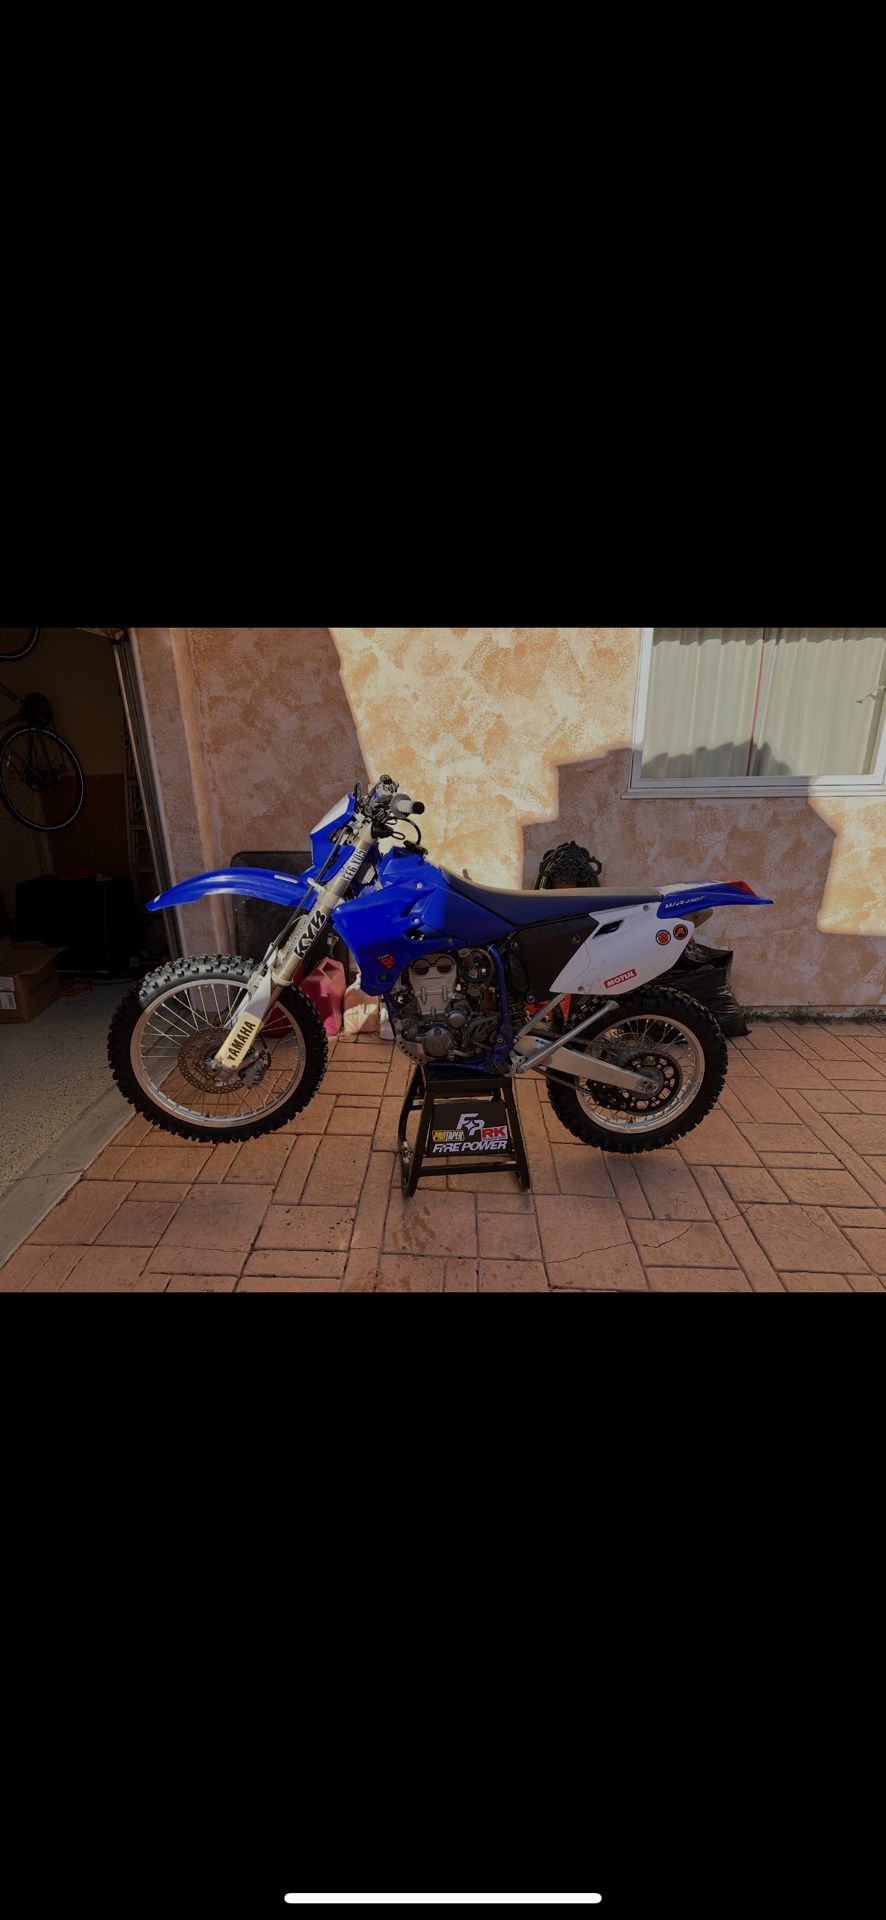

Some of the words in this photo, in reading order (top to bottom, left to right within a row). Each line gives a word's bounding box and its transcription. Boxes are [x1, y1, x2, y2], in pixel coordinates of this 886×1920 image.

[294, 910, 326, 957] KYB
[606, 970, 636, 987] MOTUL
[227, 1020, 256, 1061] YAMAHA
[481, 1127, 507, 1139] RK
[432, 1143, 462, 1153] FIRE
[461, 1140, 508, 1152] POWER
